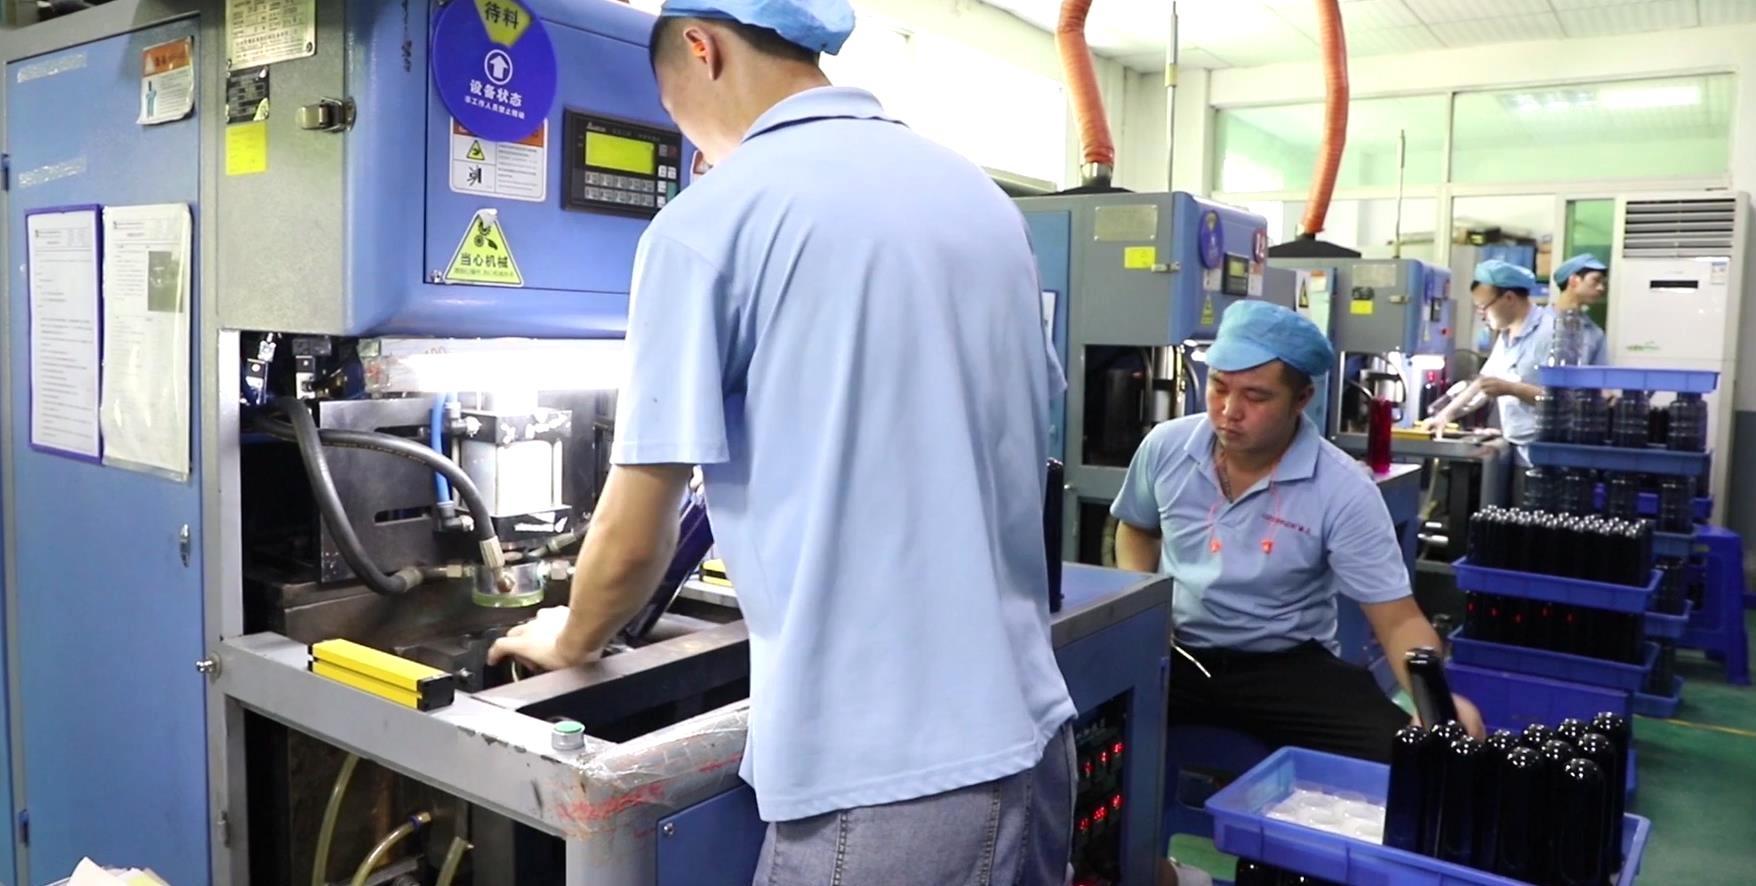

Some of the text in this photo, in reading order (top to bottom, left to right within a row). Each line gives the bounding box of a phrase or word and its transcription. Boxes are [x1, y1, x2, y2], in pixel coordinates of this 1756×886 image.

[484, 1, 519, 30] 待料
[470, 79, 522, 107] 设备状态
[460, 253, 508, 268] 当心机械
